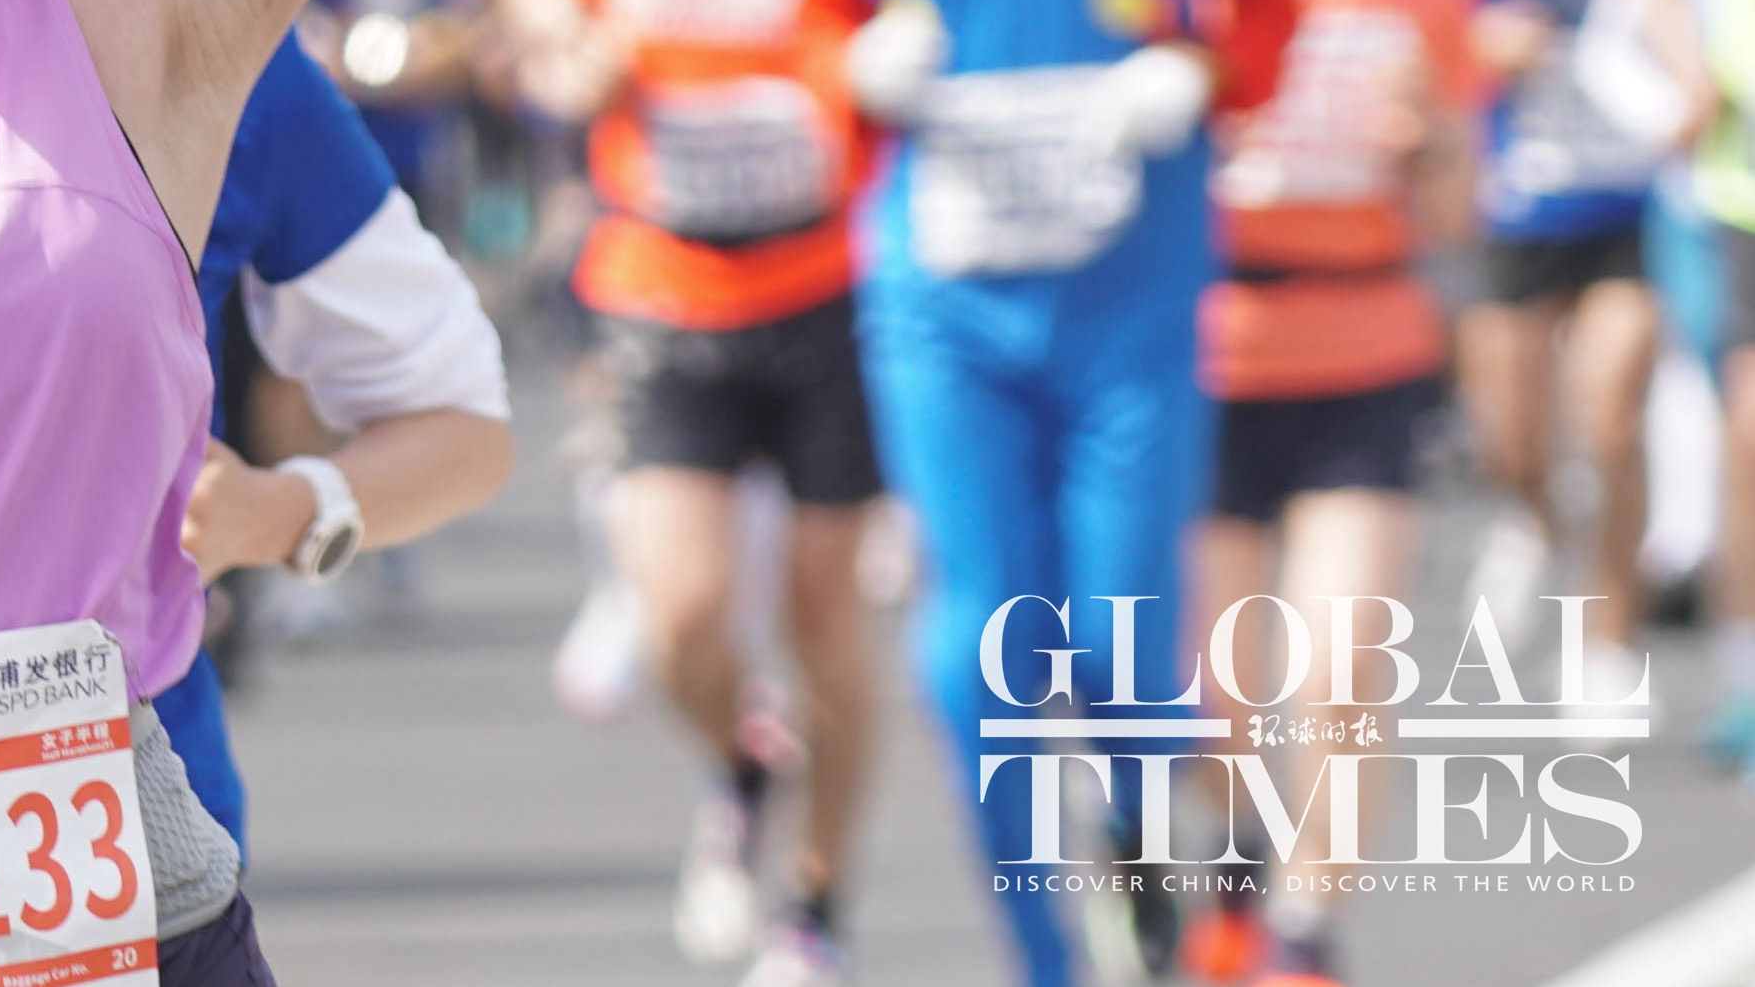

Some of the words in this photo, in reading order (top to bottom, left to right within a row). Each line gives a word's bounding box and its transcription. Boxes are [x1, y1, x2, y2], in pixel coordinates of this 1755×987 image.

[44, 677, 109, 705] BANK
[41, 721, 110, 750] 女子半程
[111, 946, 138, 971] 20
